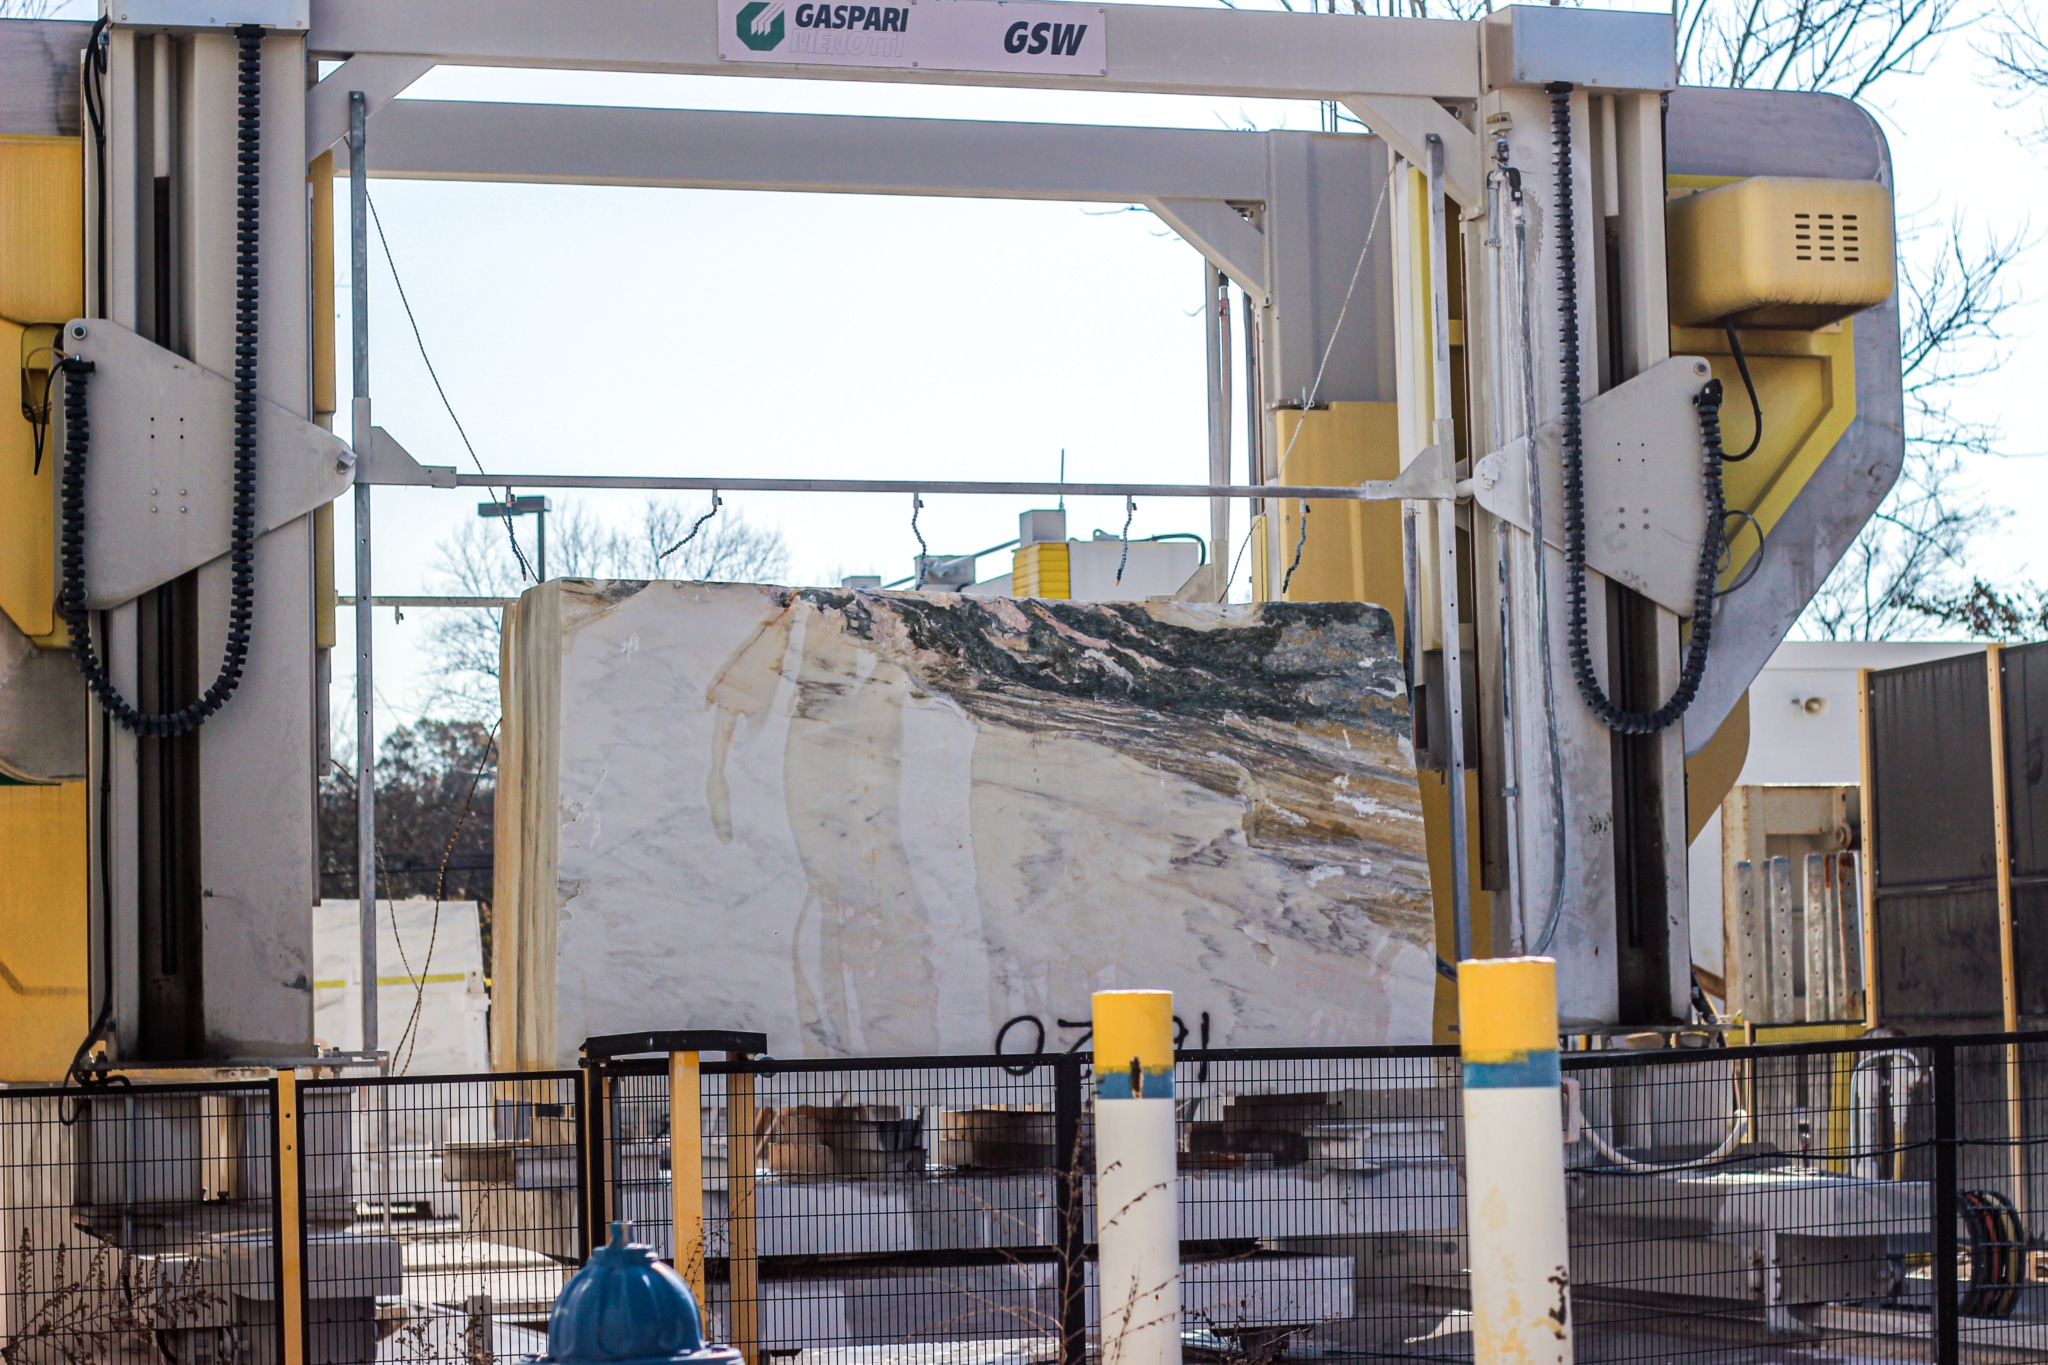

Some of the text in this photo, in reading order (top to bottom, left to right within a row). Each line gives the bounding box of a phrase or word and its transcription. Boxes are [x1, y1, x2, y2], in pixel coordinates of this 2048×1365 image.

[795, 3, 910, 32] GASPARI
[789, 27, 906, 58] MENOTTI
[1003, 21, 1088, 56] GSW
